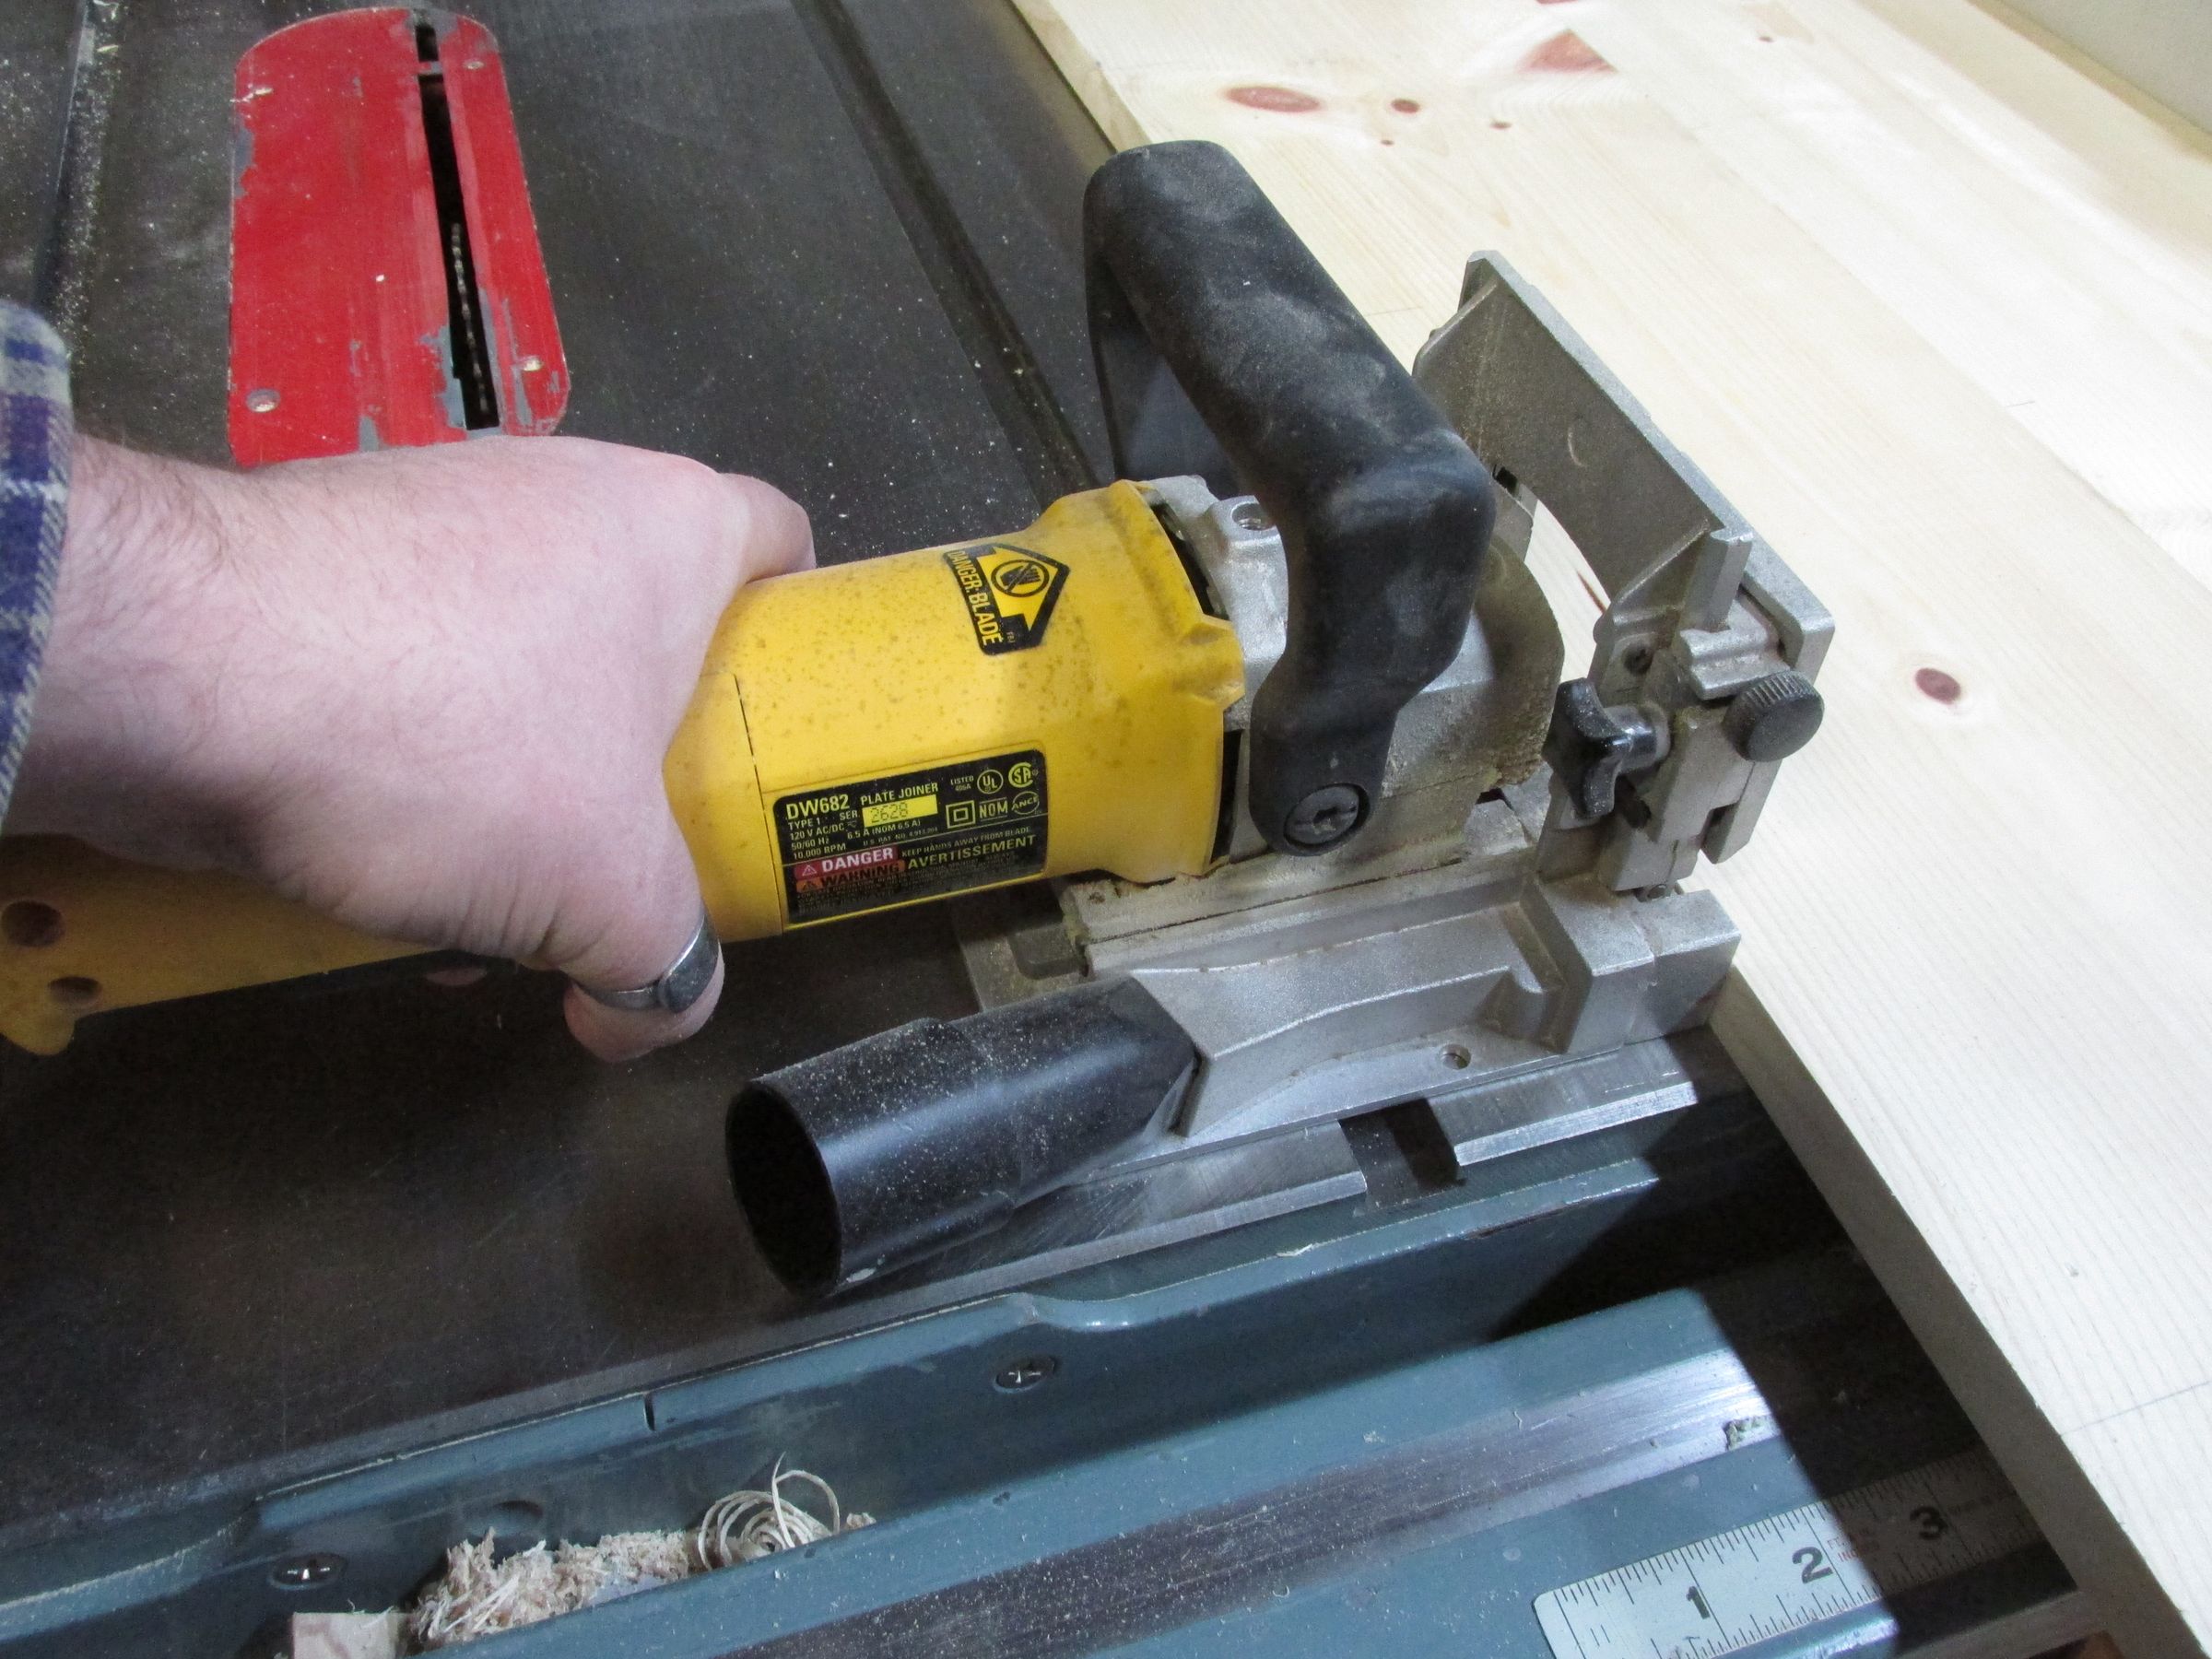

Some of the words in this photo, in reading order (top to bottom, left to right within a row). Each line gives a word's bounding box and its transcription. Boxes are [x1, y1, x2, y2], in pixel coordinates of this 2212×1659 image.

[968, 592, 1004, 646] BLADE
[950, 775, 973, 785] LISTED
[860, 791, 895, 806] PLATE
[899, 782, 938, 798] JOINER
[786, 794, 850, 819] DW682
[870, 801, 908, 823] 2628
[979, 800, 1007, 818] NOM
[788, 818, 813, 830] TYPE
[790, 830, 805, 840] 120
[806, 829, 813, 837] V
[816, 823, 844, 835] AC/DC
[847, 830, 860, 839] 6.5
[872, 824, 896, 834] (NOM
[792, 839, 815, 850] 50/60
[824, 842, 845, 853] RPM
[954, 836, 978, 846] AWAY
[981, 831, 1003, 841] FROM
[822, 848, 892, 872] DANGER
[908, 834, 1035, 869] AVERTISSEMENT
[822, 864, 899, 886] WARNING
[1686, 1586, 1711, 1619] 1
[1792, 1547, 1833, 1583] 2
[1910, 1506, 1946, 1540] 3
